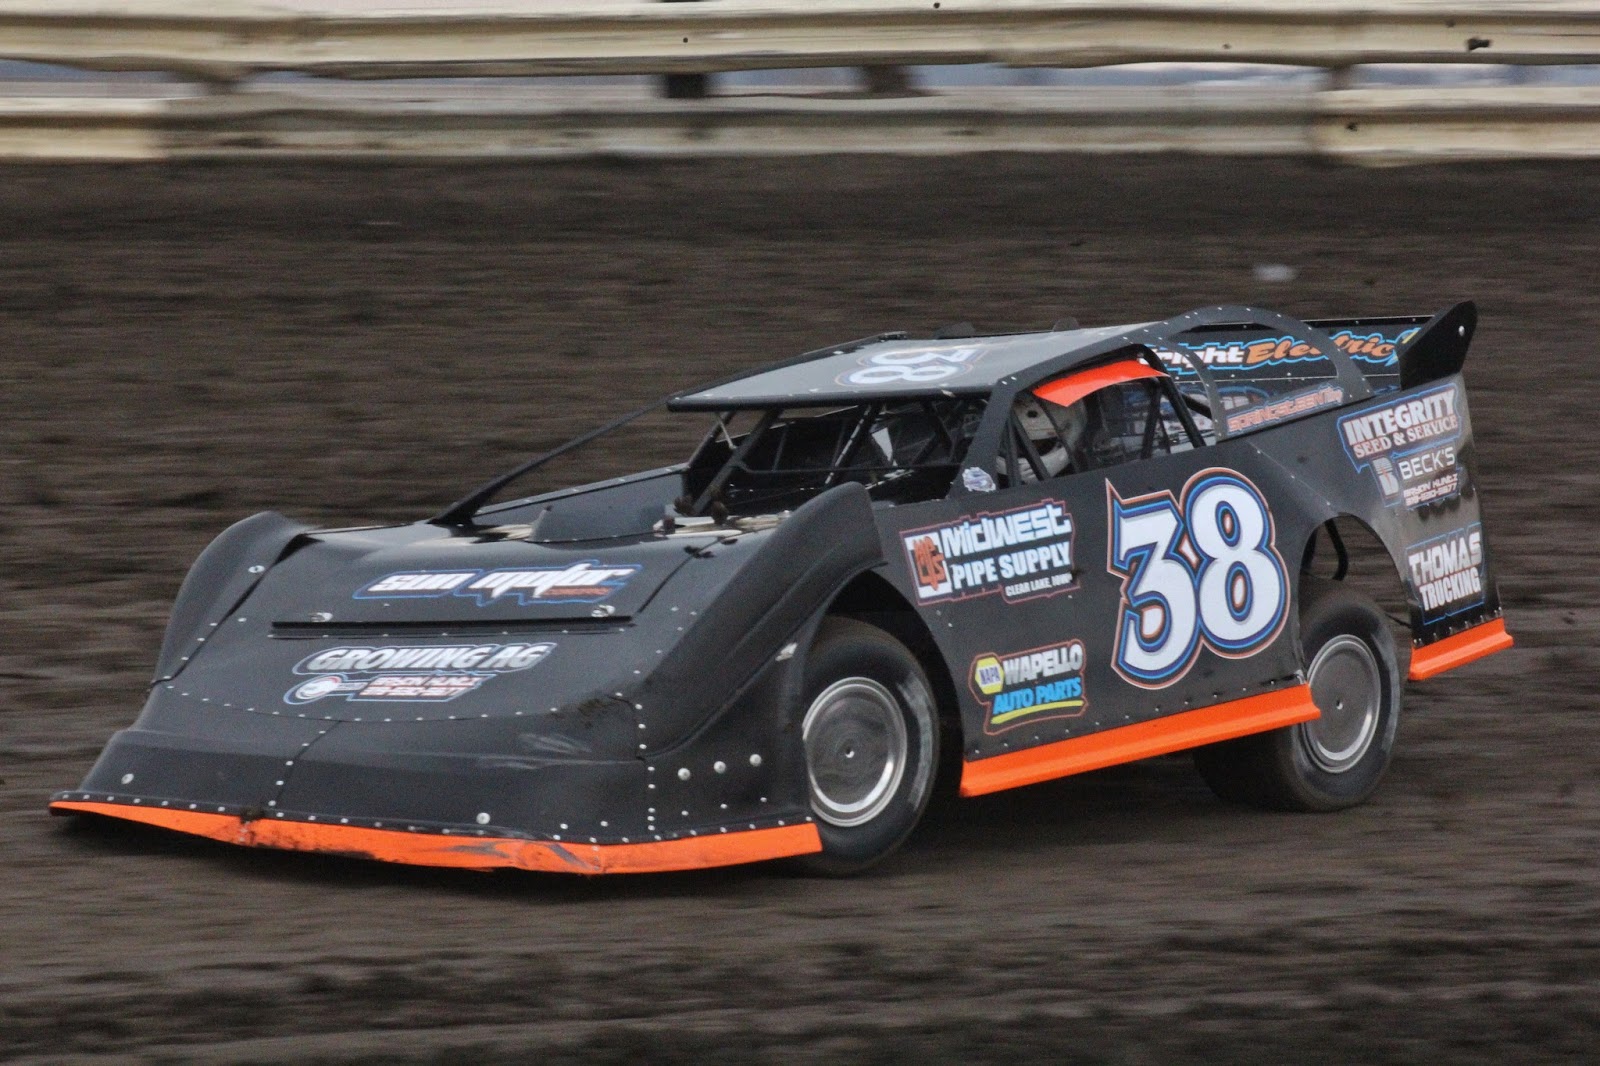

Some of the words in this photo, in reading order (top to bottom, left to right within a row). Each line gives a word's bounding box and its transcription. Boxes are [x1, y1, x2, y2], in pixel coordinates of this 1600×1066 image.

[1343, 389, 1457, 445] INTEGRITY
[1353, 436, 1392, 460] SEED
[1393, 430, 1407, 446] &
[1407, 414, 1459, 442] SERVICE
[1398, 446, 1456, 480] BECK'S
[951, 557, 998, 590] PIPE
[998, 541, 1071, 579] SUPPLY
[1108, 470, 1289, 687] 38
[1408, 532, 1482, 586] THOMAS
[1005, 583, 1030, 597] CLEAR
[1419, 567, 1482, 612] TRUCKING
[306, 647, 491, 671] GROWING
[1003, 643, 1083, 686] WAPELLO
[993, 688, 1034, 715] AUTO
[1035, 677, 1082, 704] PARTS
